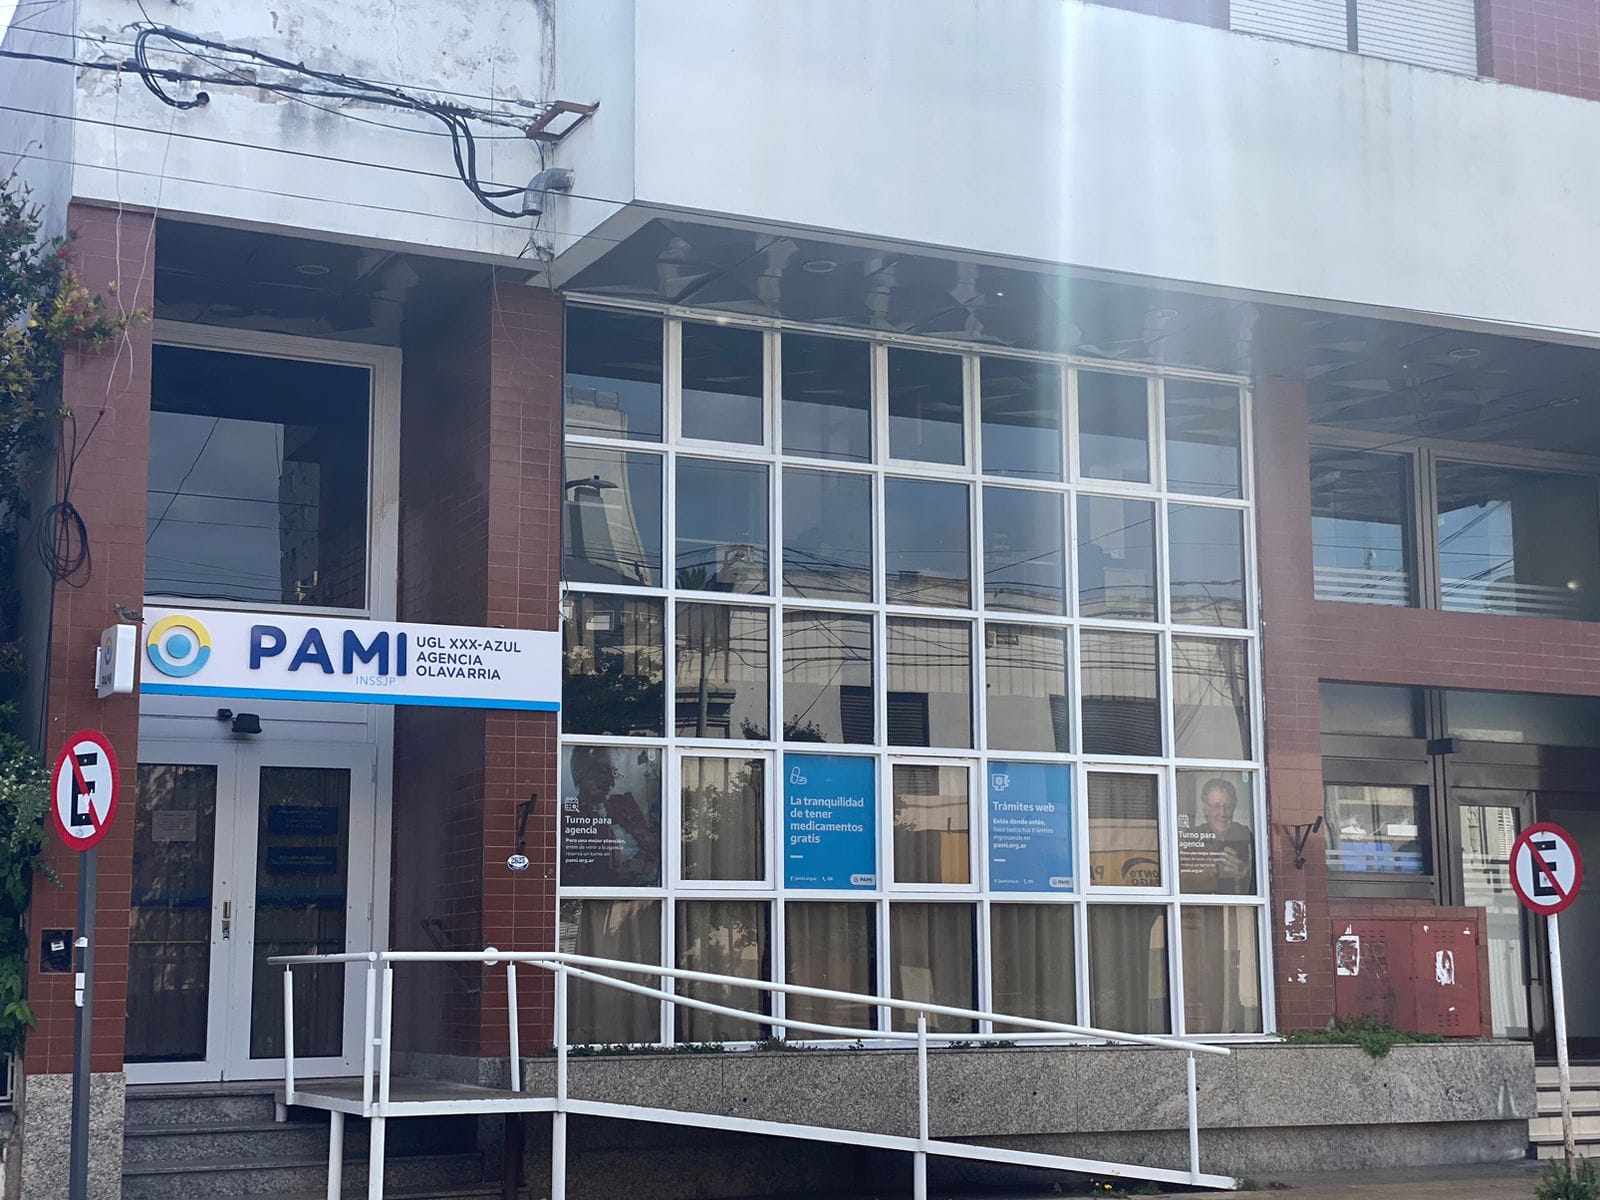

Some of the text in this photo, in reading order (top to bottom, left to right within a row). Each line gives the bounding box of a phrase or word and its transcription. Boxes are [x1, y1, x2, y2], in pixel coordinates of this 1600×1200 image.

[249, 624, 407, 677] PAMI
[416, 636, 522, 653] UGL XXX-AZUL
[416, 651, 483, 666] AGENCIA
[415, 665, 502, 680] OLAVARRIA
[355, 675, 396, 687] INSSJP
[71, 753, 97, 827] E
[790, 795, 864, 809] La tranquilidad
[992, 800, 1055, 813] Trámites web
[790, 807, 833, 819] de tener
[565, 815, 612, 826] Turno para
[790, 820, 864, 832] medicamentos
[565, 825, 598, 836] agencia
[1178, 830, 1217, 841] Turno para
[790, 833, 821, 845] gratis
[1178, 840, 1205, 849] agencia
[1530, 840, 1558, 897] E
